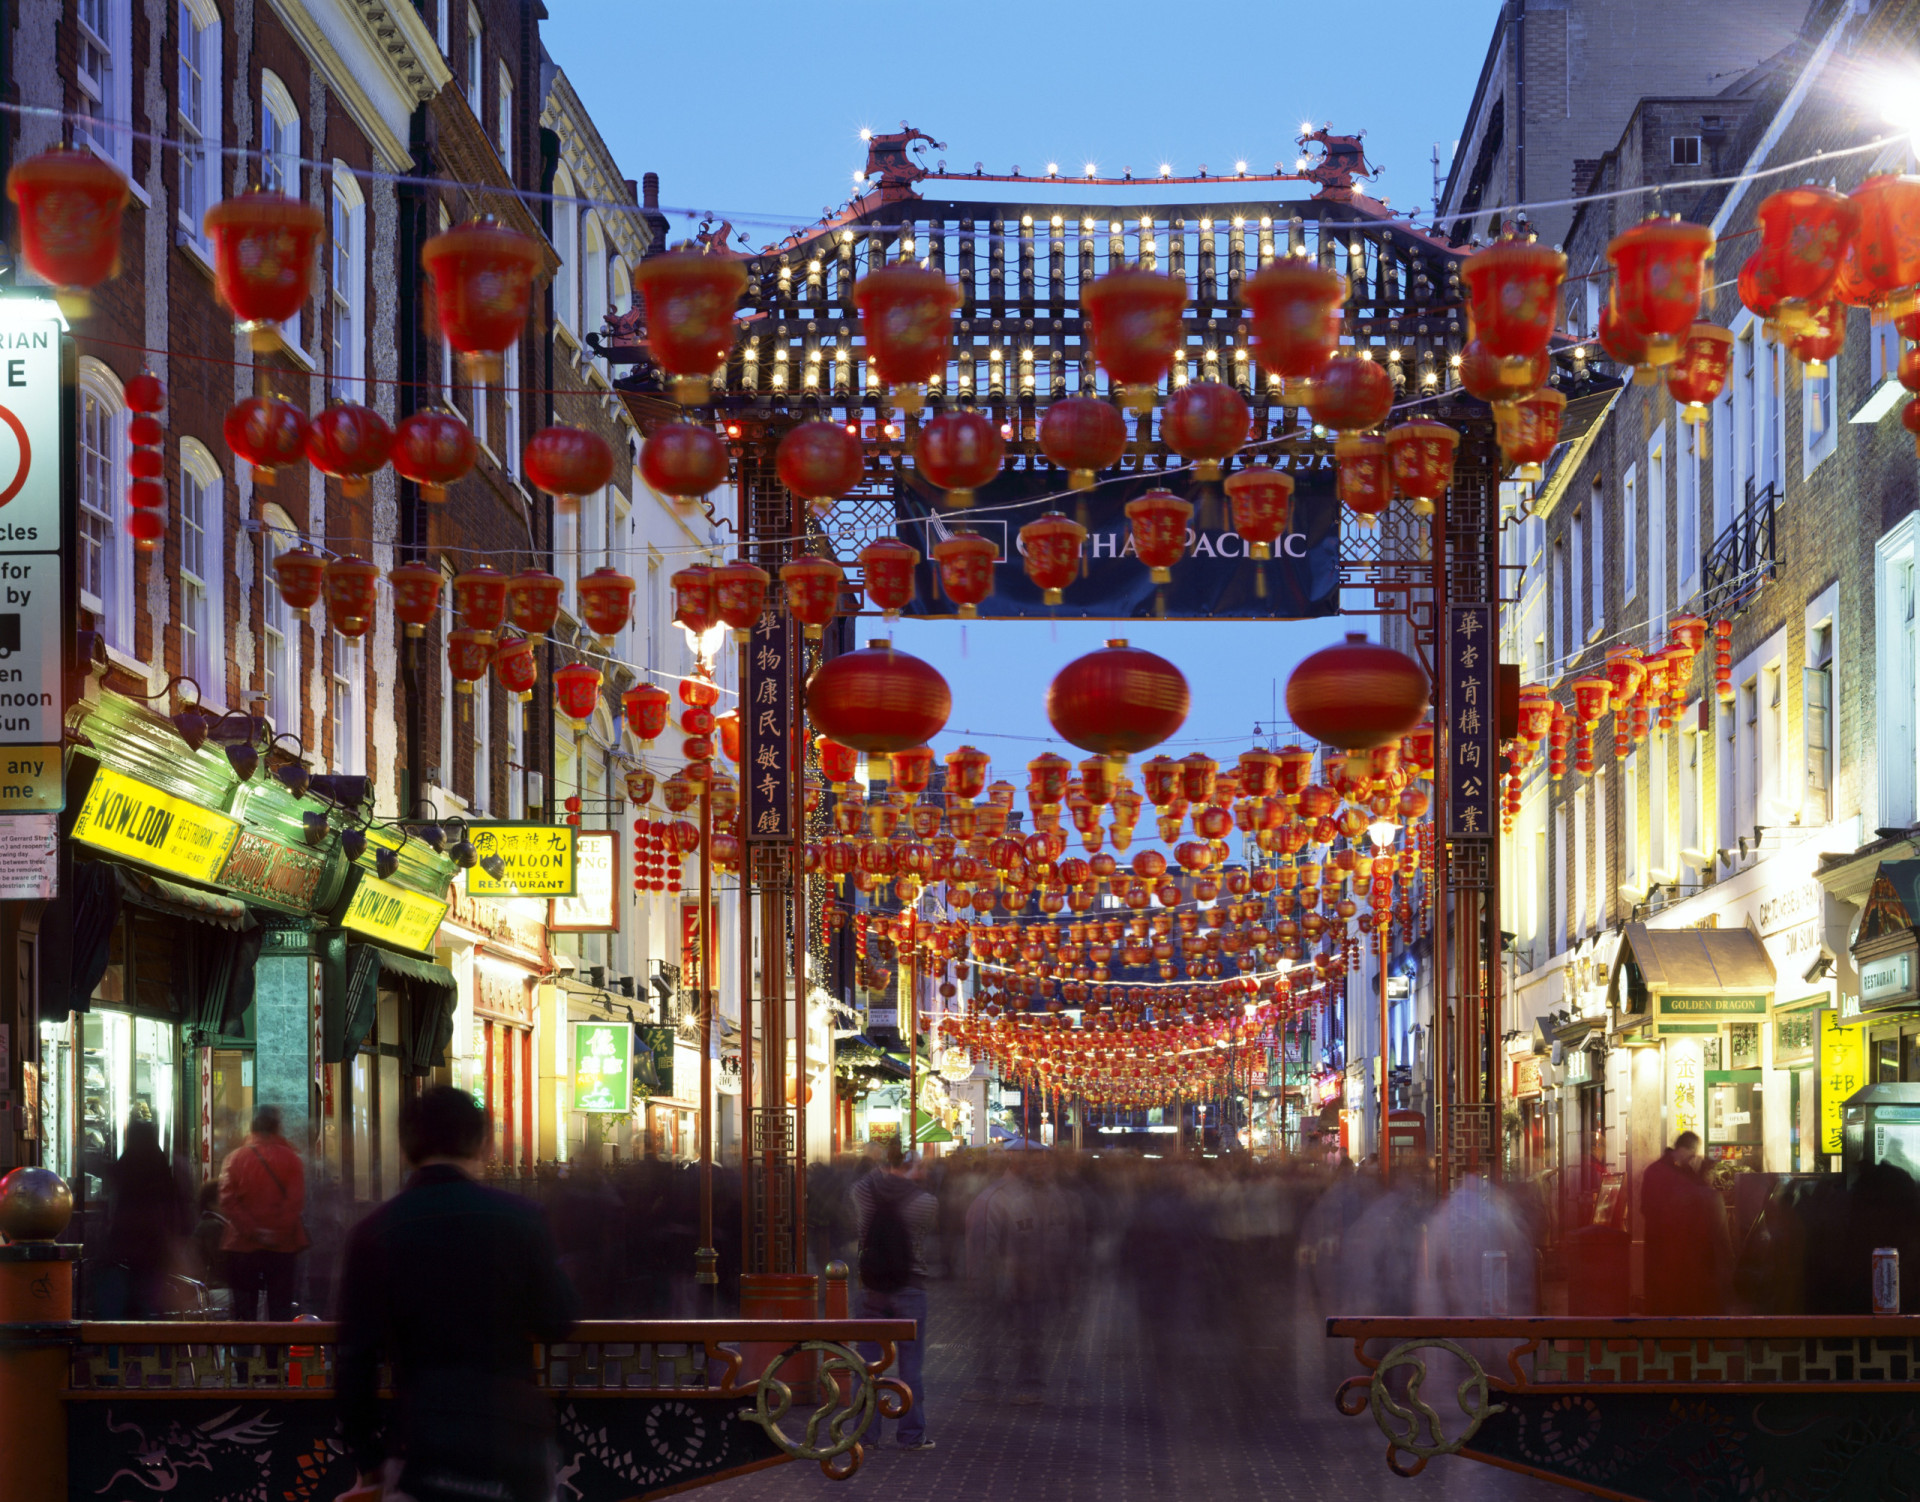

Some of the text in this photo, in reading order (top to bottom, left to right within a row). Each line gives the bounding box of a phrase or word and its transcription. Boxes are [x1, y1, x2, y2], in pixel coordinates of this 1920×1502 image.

[7, 359, 27, 387] E
[1, 562, 31, 579] for
[7, 586, 31, 607] by
[0, 715, 30, 731] un
[8, 761, 44, 777] any
[93, 788, 175, 849] KOWLOON
[503, 871, 549, 879] HINESE
[478, 880, 564, 889] RESTAURANT
[354, 888, 406, 929] KOWLOON
[1863, 968, 1897, 991] RESTAURANT
[1671, 1000, 1756, 1010] GOLDEN DRAGON
